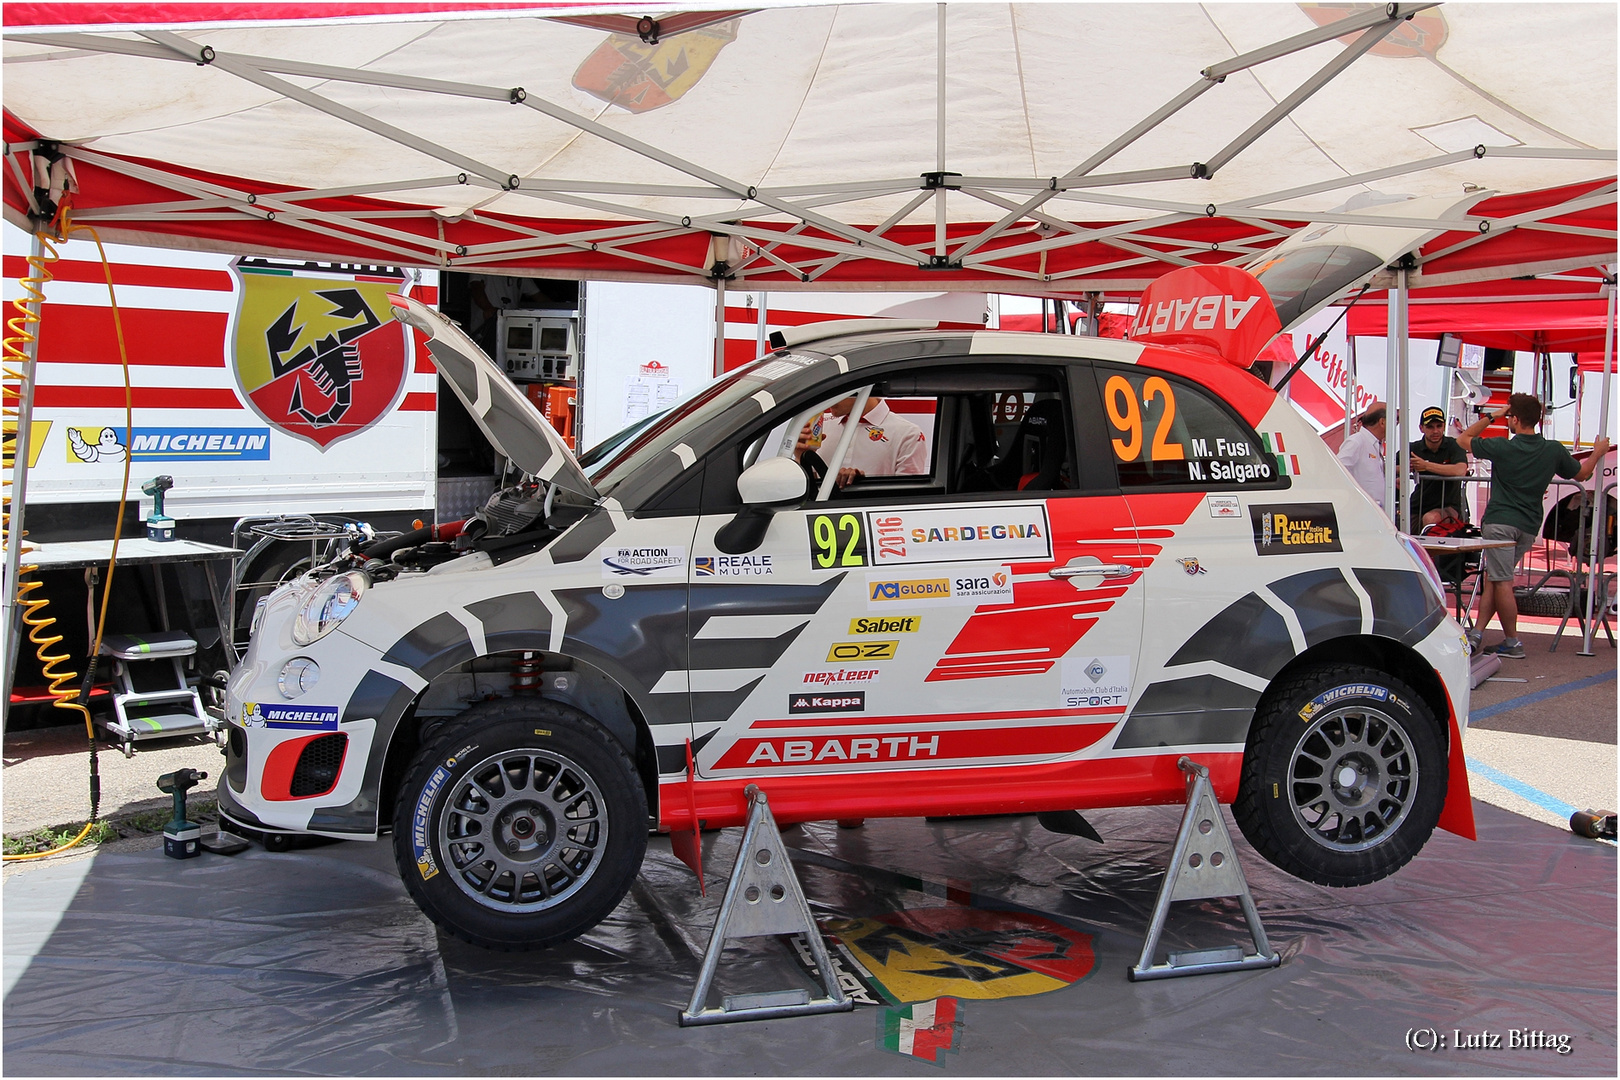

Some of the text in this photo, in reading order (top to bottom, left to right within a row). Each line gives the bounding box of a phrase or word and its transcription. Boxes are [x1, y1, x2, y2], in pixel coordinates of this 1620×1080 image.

[1104, 375, 1185, 462] 92
[133, 434, 267, 451] MICHELIN
[1191, 438, 1251, 457] M. Fusi
[1188, 460, 1271, 483] N. Salgaro
[813, 514, 864, 568] 92
[876, 516, 907, 559] 2016
[911, 523, 1042, 543] SARDEGNA
[1282, 527, 1333, 545] talent
[632, 549, 668, 557] ACTION
[654, 557, 682, 565] SAFETY
[719, 556, 772, 567] REALE
[720, 568, 773, 576] MUTUA
[901, 583, 949, 595] GLOBAL
[956, 576, 990, 590] sara
[971, 588, 1012, 596] assicurazioni
[855, 617, 914, 634] Sabelt
[803, 668, 879, 686] nexteer
[1061, 685, 1128, 695] Automobile Club d'Italia
[1323, 685, 1385, 704] MICHELIN
[812, 697, 861, 707] Kappa
[1067, 695, 1122, 707] SPORT
[268, 710, 337, 722] MICHELIN
[746, 735, 940, 764] ABARTH
[415, 769, 446, 848] MICHELIN
